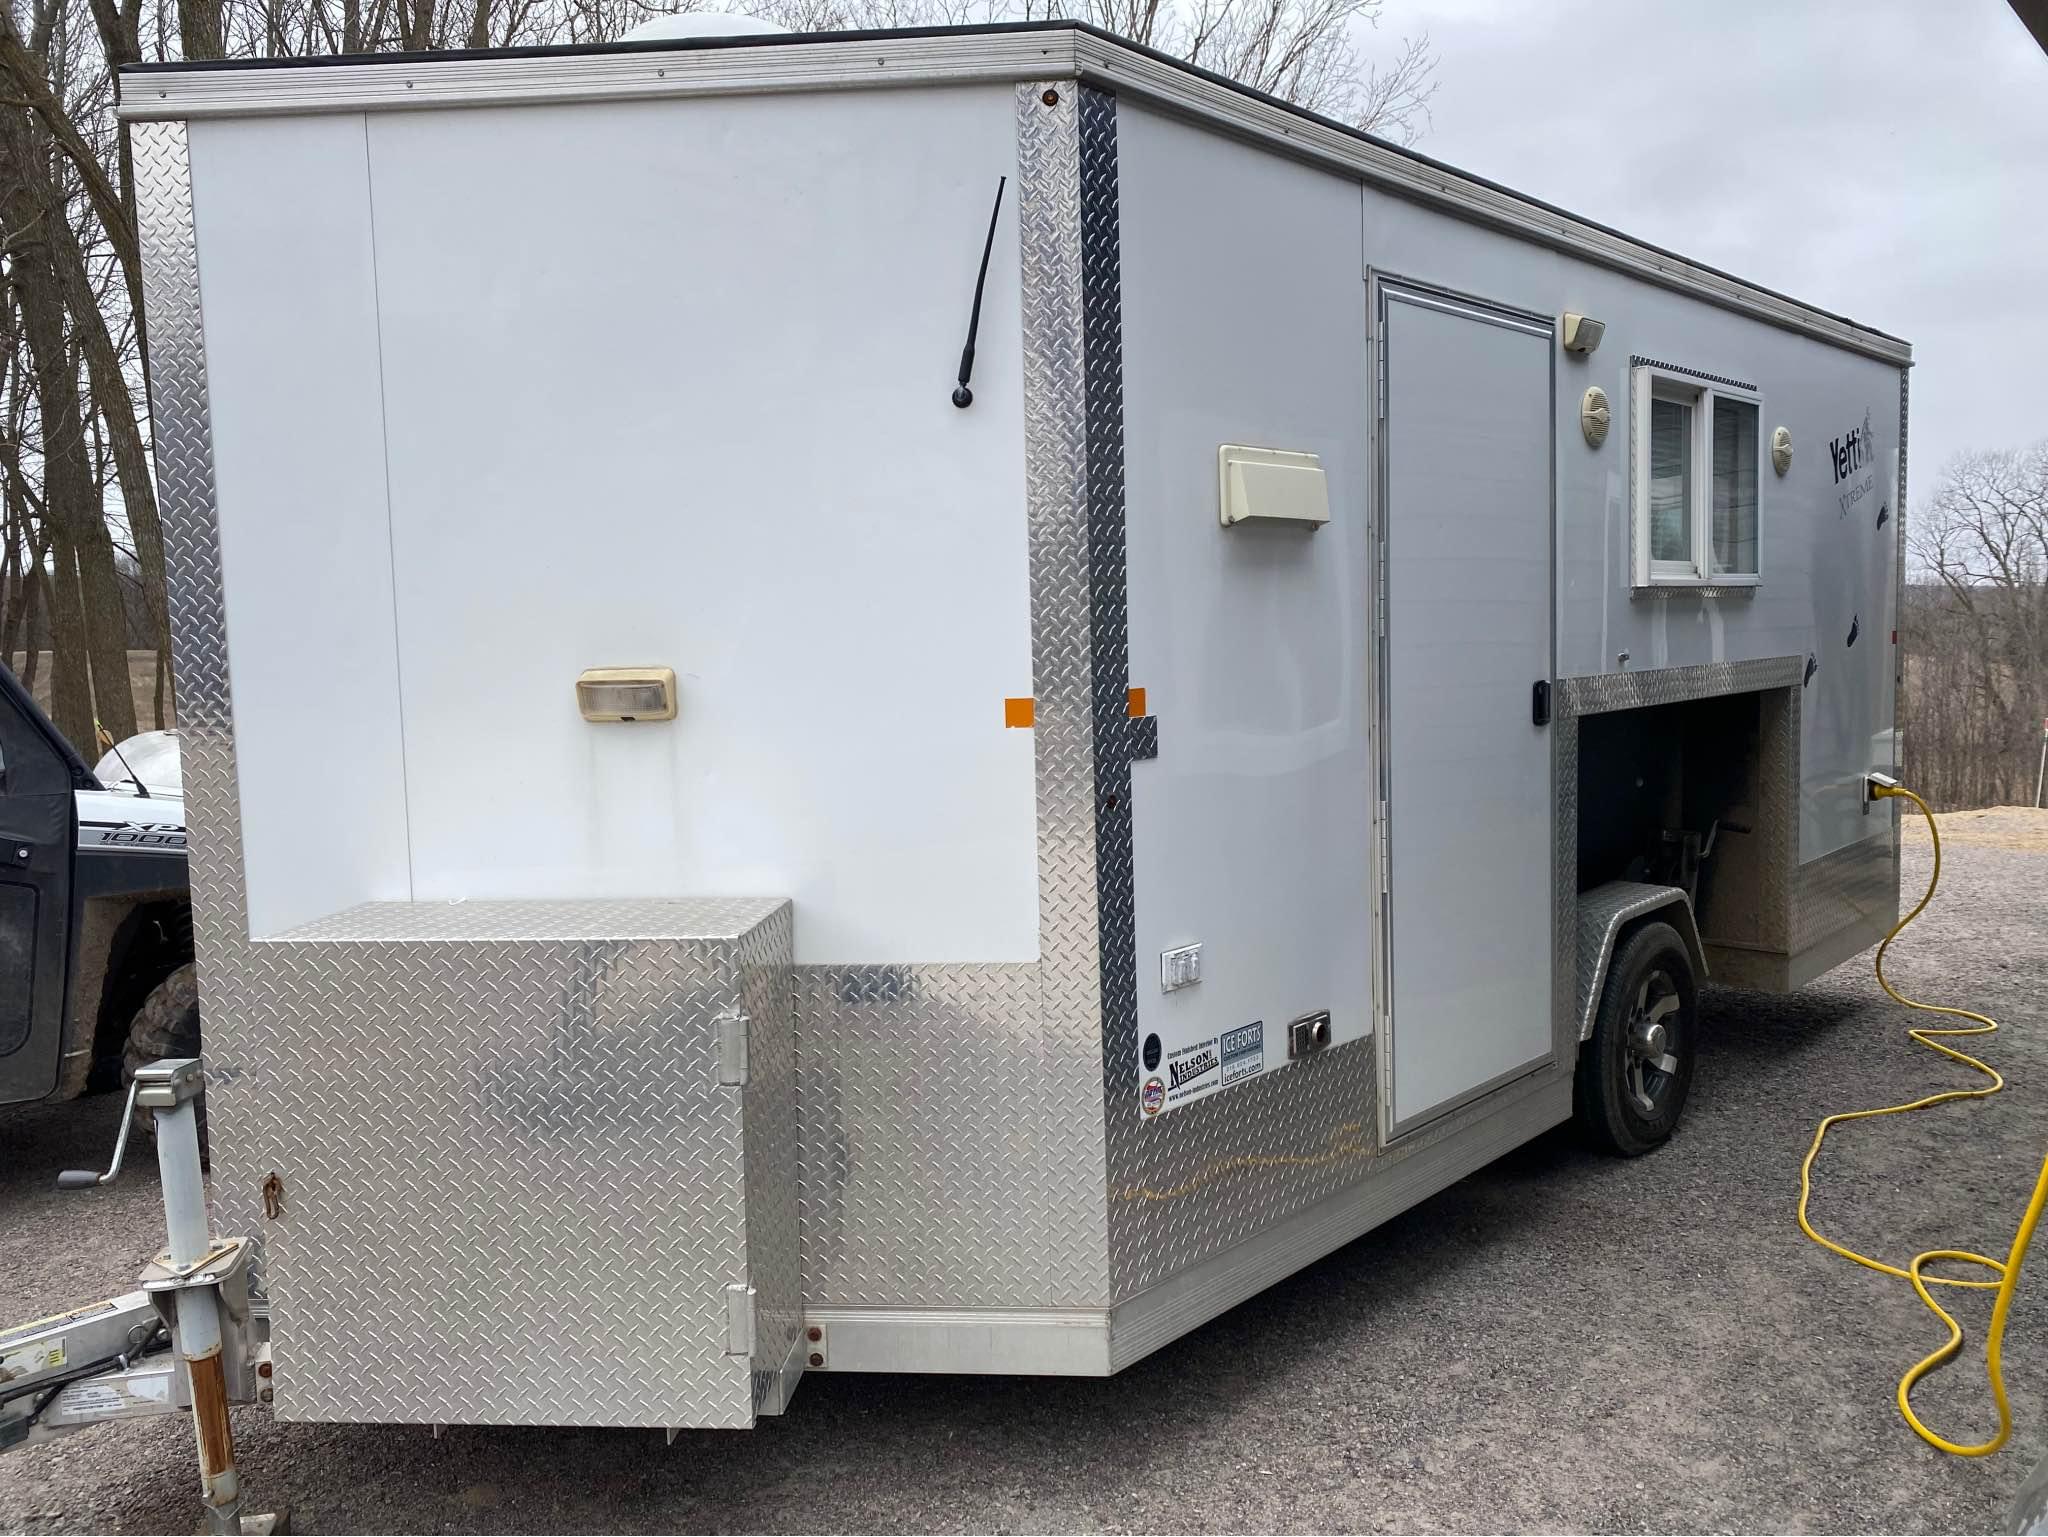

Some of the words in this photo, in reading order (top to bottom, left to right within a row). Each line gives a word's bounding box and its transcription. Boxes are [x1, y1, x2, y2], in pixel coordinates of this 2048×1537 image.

[1829, 427, 1862, 485] Yetti
[1838, 474, 1874, 520] XTREME
[101, 831, 187, 845] 1000
[119, 820, 179, 832] XP
[1223, 1035, 1235, 1054] ICE
[1237, 1026, 1261, 1049] FORTS
[1179, 1056, 1218, 1082] INDUSTRIES
[1224, 1062, 1261, 1083] iceforts.com
